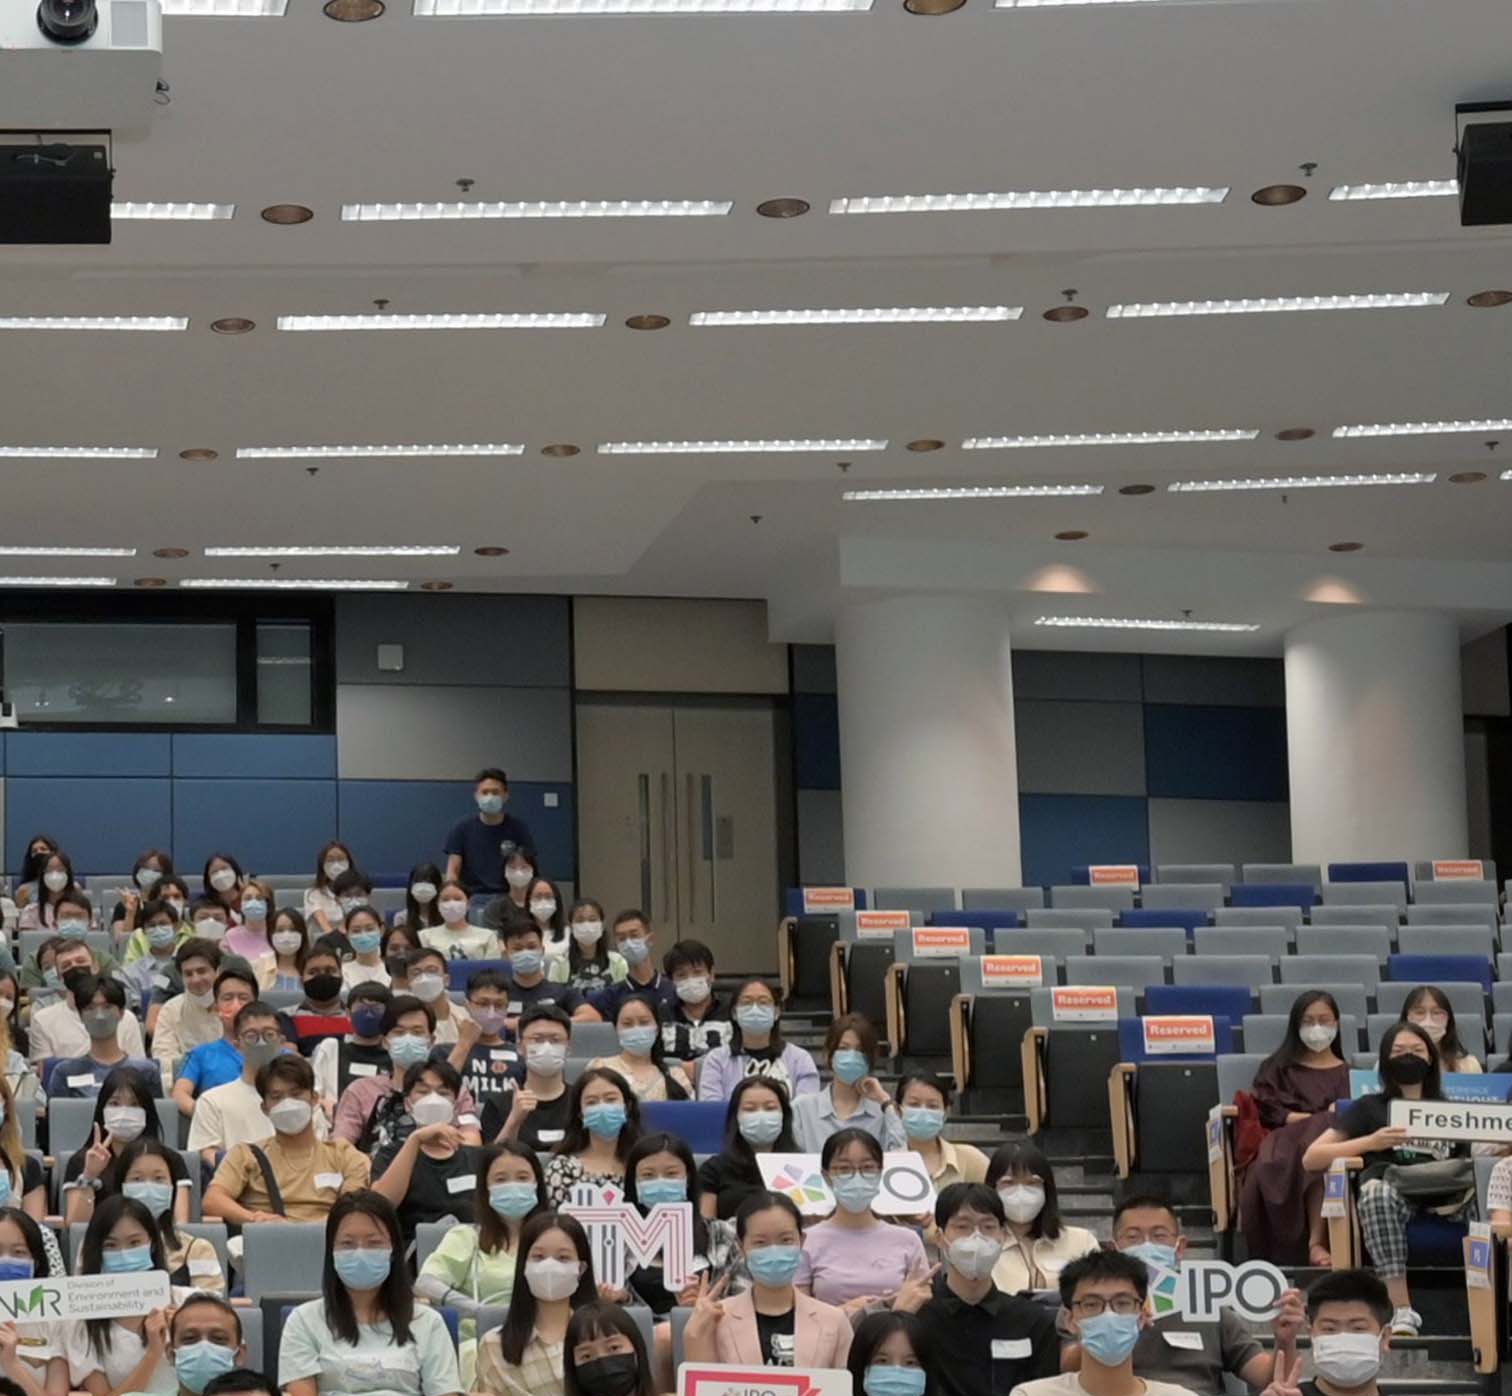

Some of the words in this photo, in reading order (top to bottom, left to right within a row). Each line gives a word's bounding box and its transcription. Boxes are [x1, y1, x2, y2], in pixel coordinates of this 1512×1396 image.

[986, 962, 1037, 974] Reserved
[1058, 994, 1111, 1007] Reserved
[1150, 1023, 1208, 1036] Reserved
[463, 1076, 517, 1093] MILK
[68, 1289, 140, 1304] Environment
[142, 1287, 165, 1298] and
[1188, 1268, 1281, 1315] IPO
[68, 1300, 145, 1315] Sustainability
